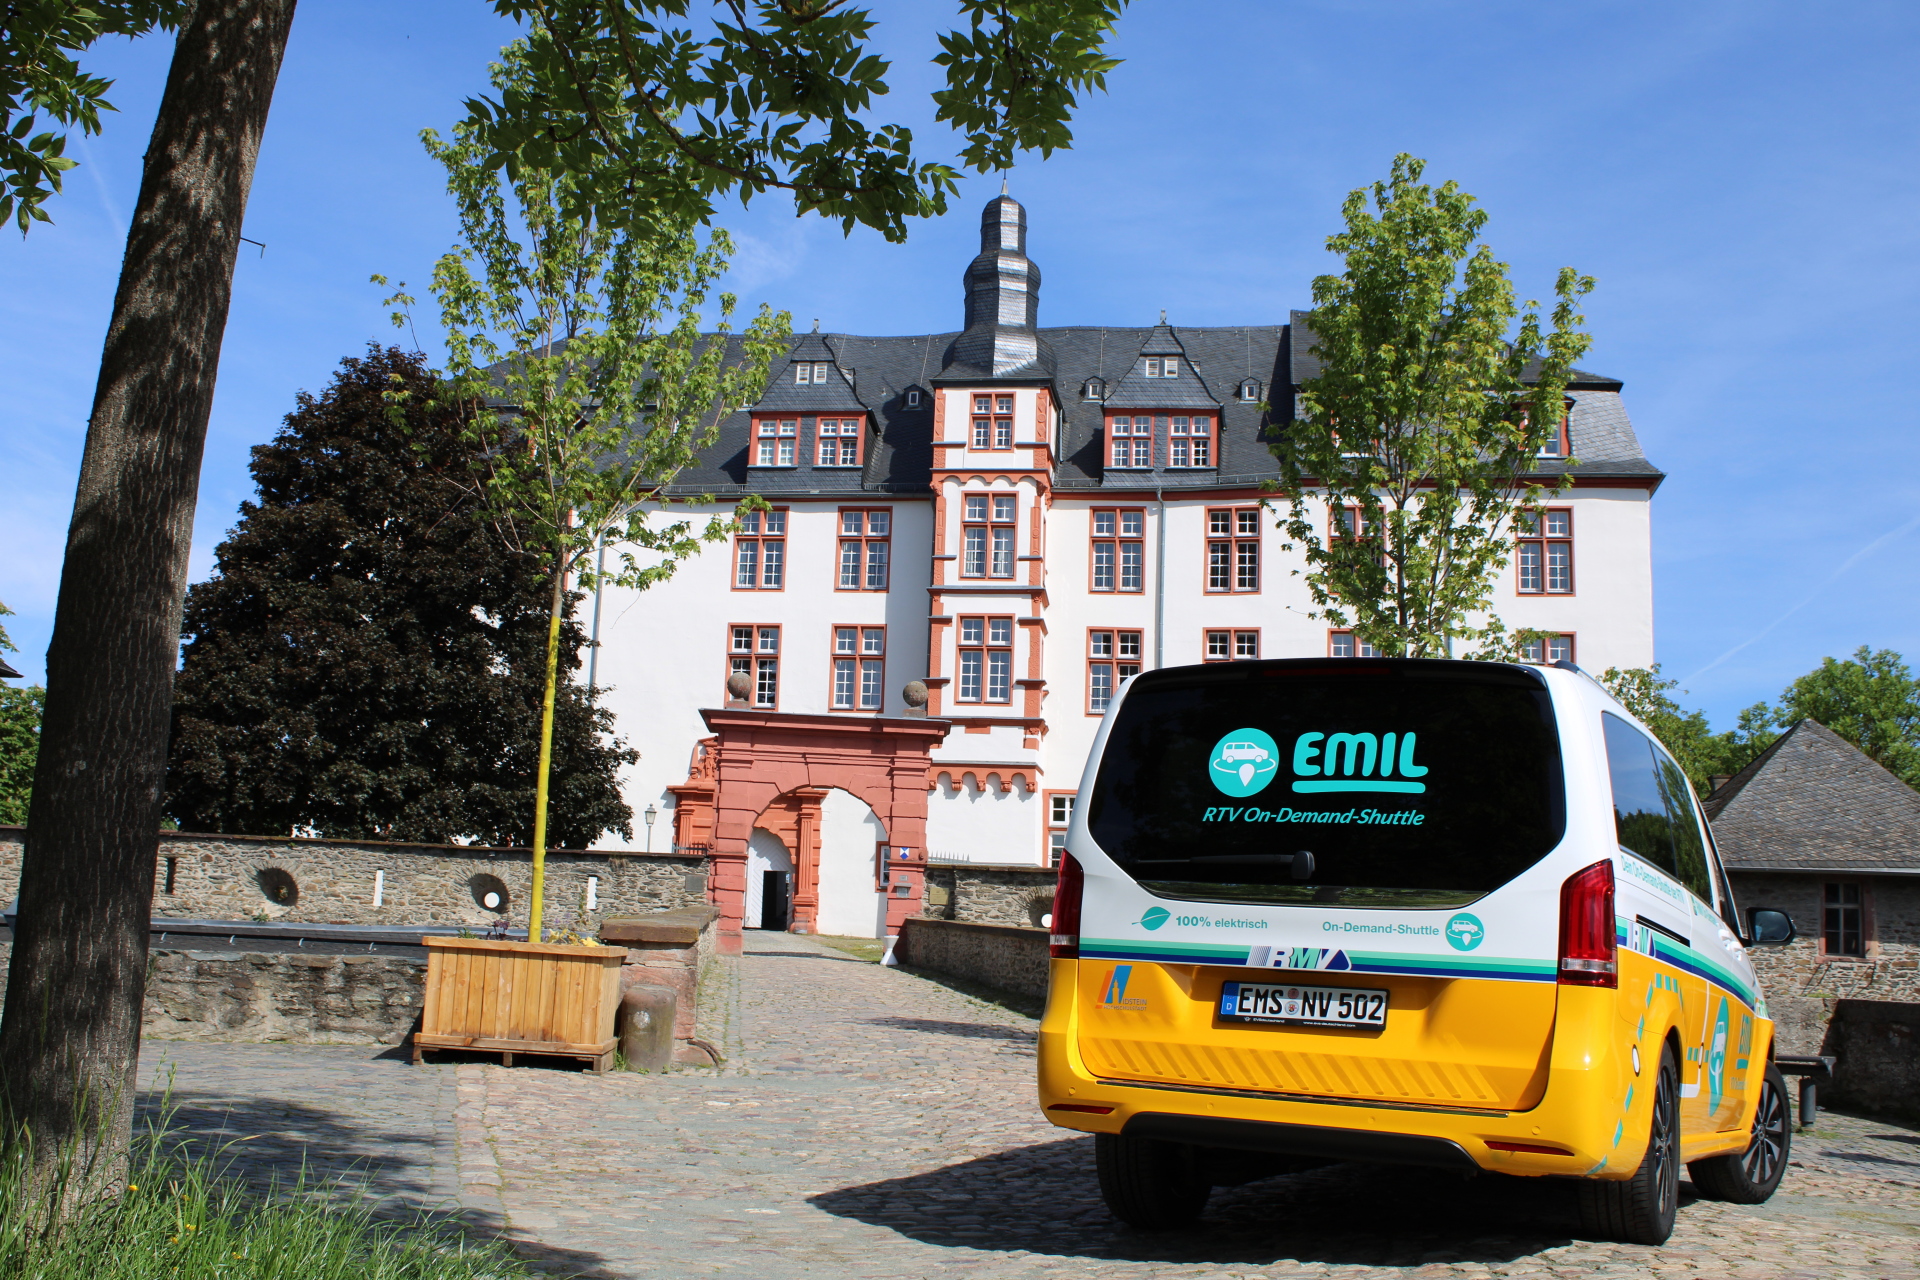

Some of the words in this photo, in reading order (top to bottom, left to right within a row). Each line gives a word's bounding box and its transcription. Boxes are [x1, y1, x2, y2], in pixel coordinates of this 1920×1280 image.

[1292, 731, 1429, 778] EMIL
[1202, 807, 1244, 822] RTV
[1244, 807, 1425, 826] On-Demand-Shuttle
[1176, 915, 1211, 927] 100%
[1214, 918, 1268, 929] elektrisch
[1322, 921, 1440, 936] On-Demand-Shuttle
[1266, 946, 1342, 969] RMV
[1238, 988, 1284, 1015] EMS
[1301, 991, 1332, 1017] NV
[1338, 993, 1383, 1021] 502
